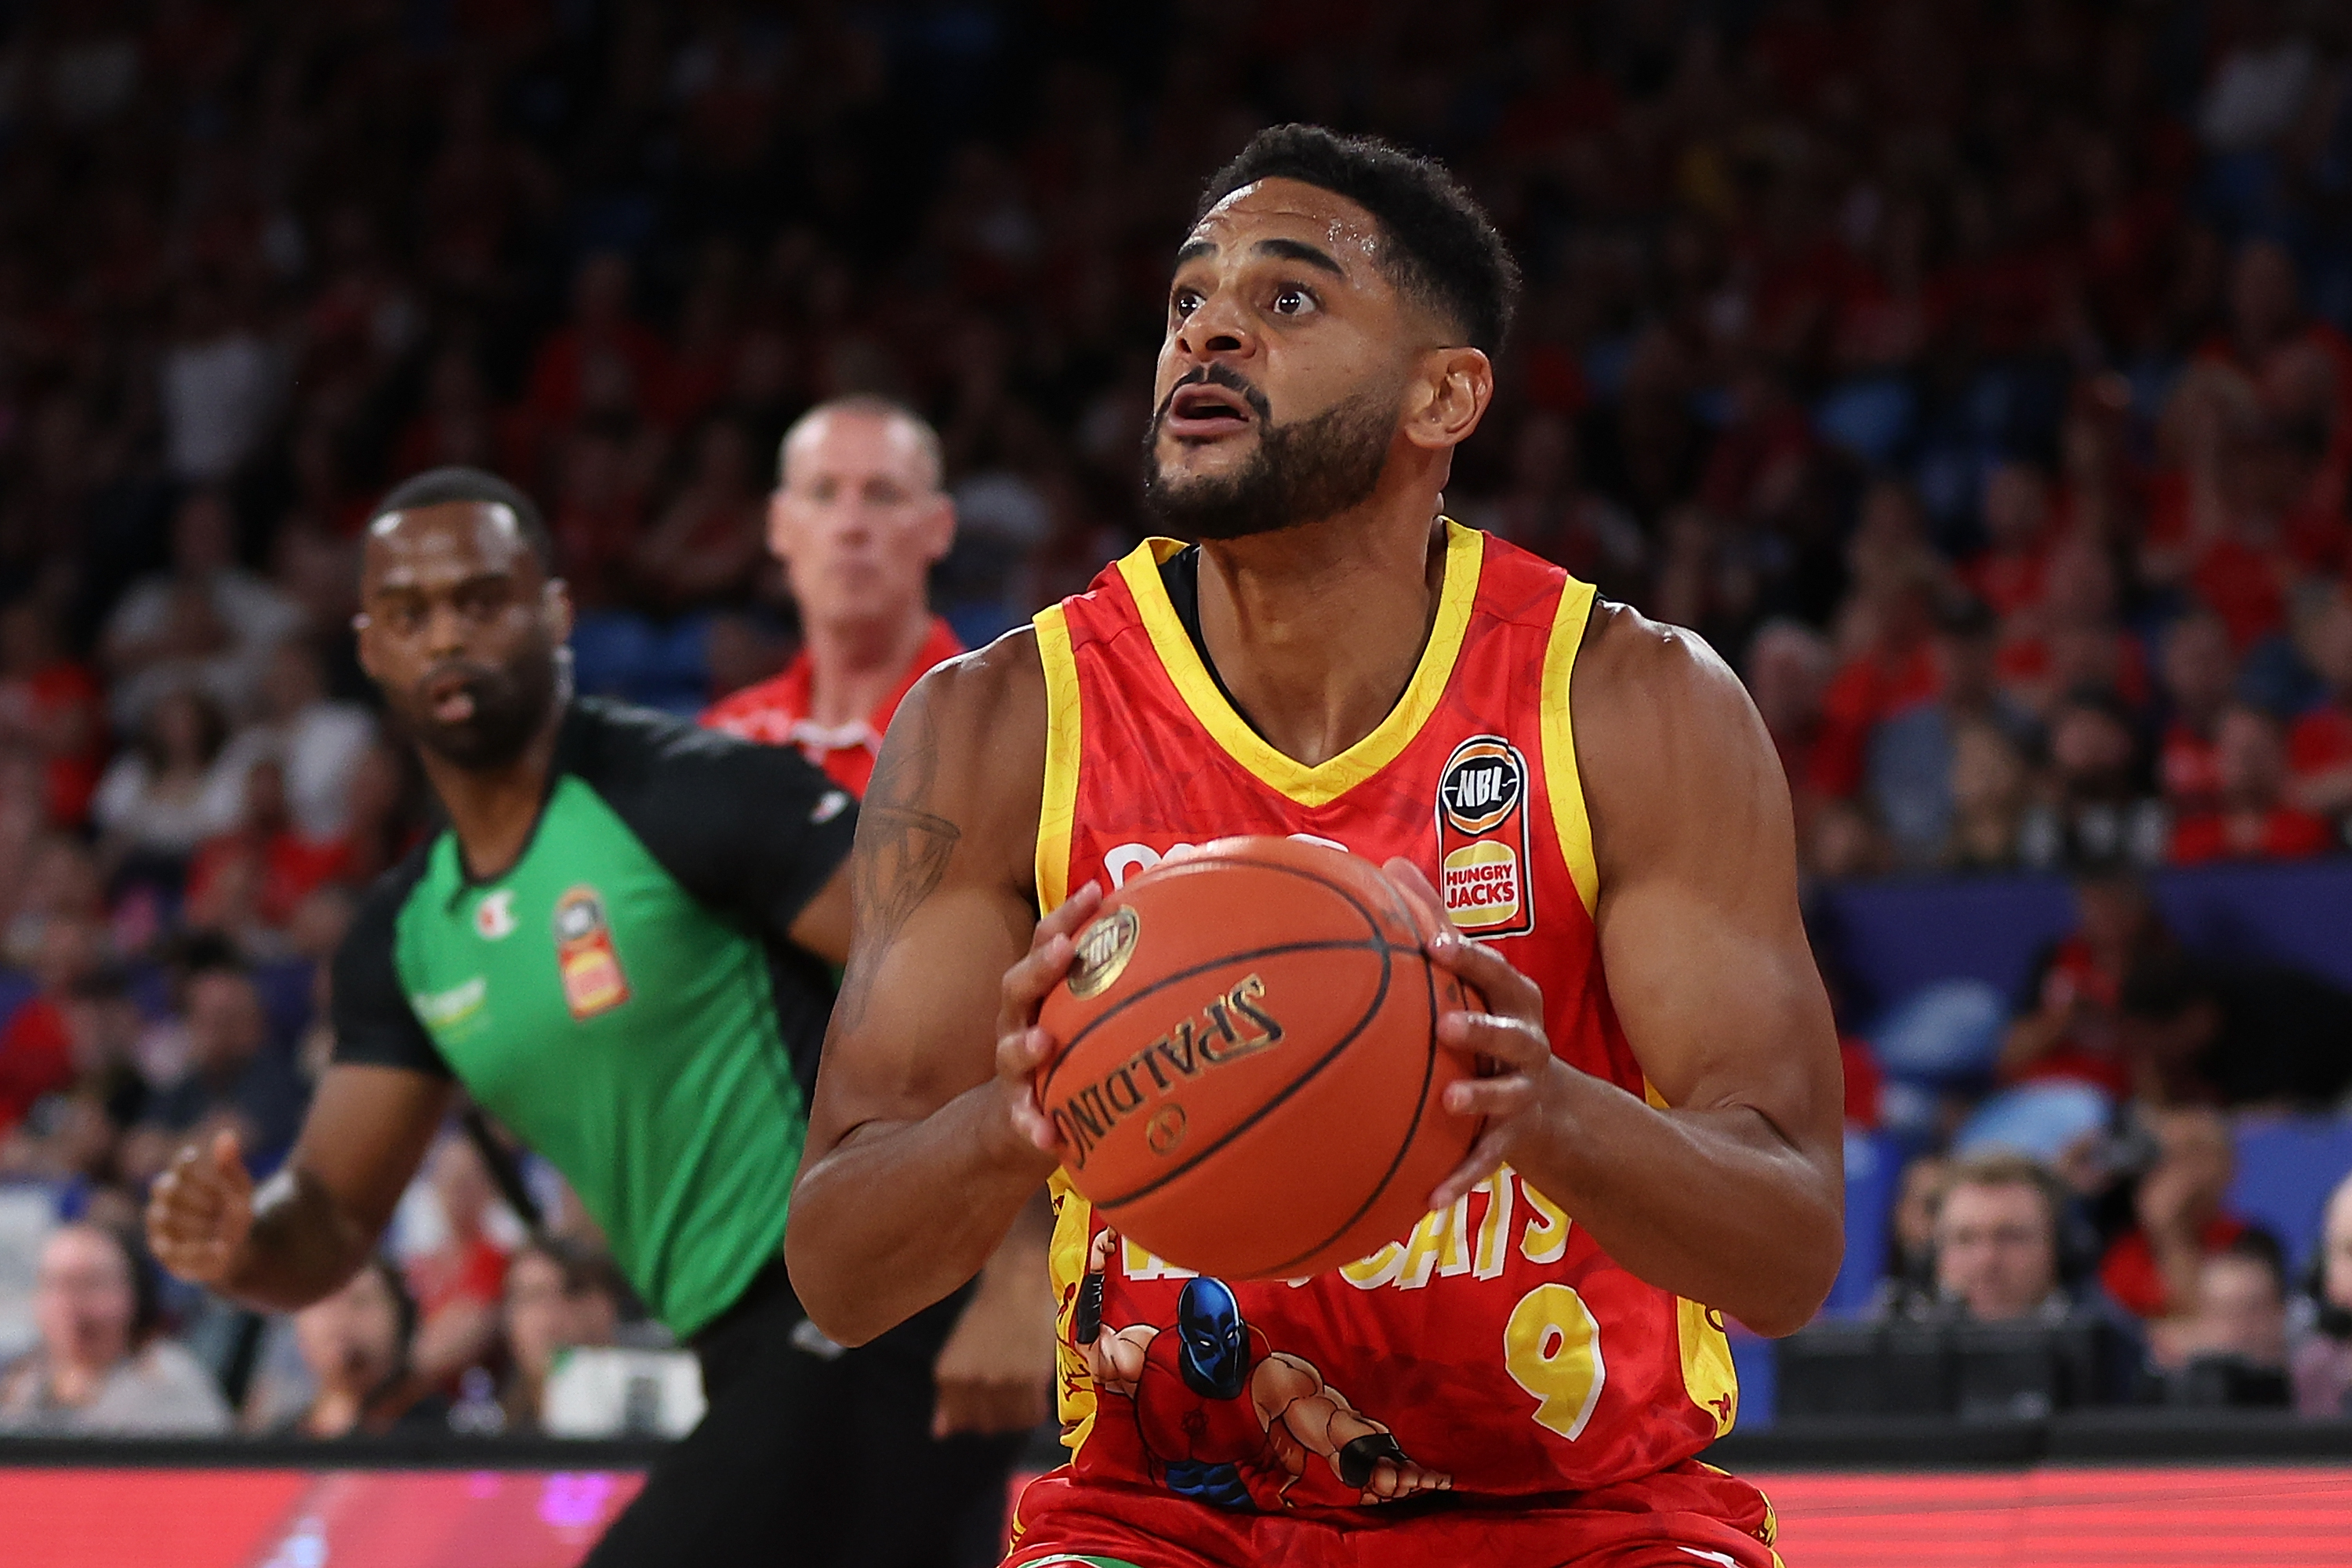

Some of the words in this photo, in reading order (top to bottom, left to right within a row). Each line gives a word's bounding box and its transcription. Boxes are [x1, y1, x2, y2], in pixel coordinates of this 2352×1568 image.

[1456, 766, 1503, 808] NBL
[1446, 864, 1513, 886] HUNGRY
[1051, 974, 1283, 1170] SPALDING
[1504, 1283, 1605, 1442] 9
